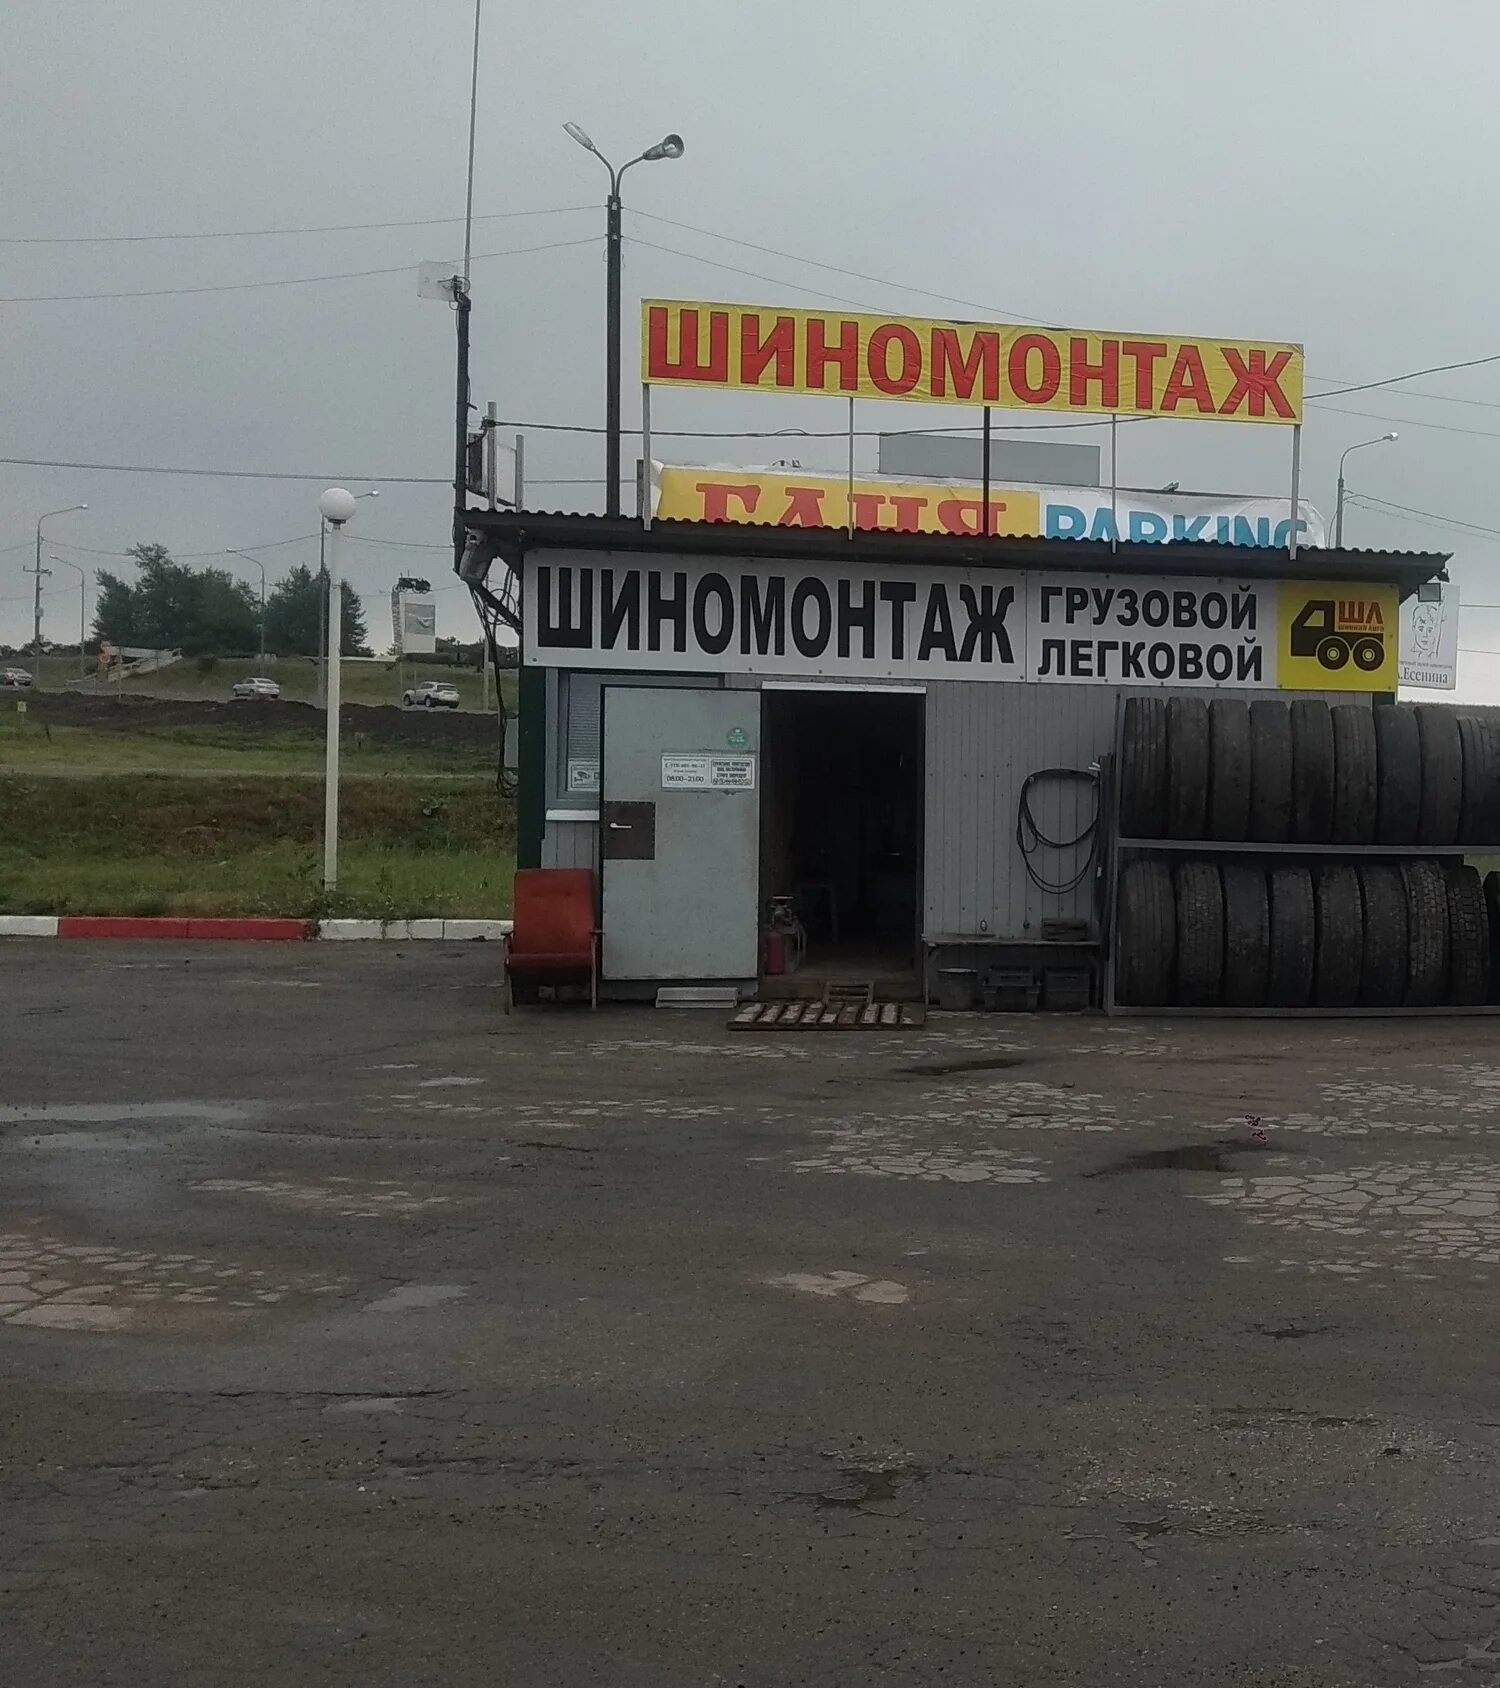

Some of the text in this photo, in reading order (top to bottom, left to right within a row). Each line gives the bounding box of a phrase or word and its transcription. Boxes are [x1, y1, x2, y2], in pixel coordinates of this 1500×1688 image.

[646, 306, 1297, 419] ШИНОМОНТАЖ
[536, 565, 1014, 665] ШИНОМОНТАЖ
[1038, 582, 1258, 630] ГРУЗОВОЙ
[1037, 637, 1262, 682] ЛЕГКОВОЙ
